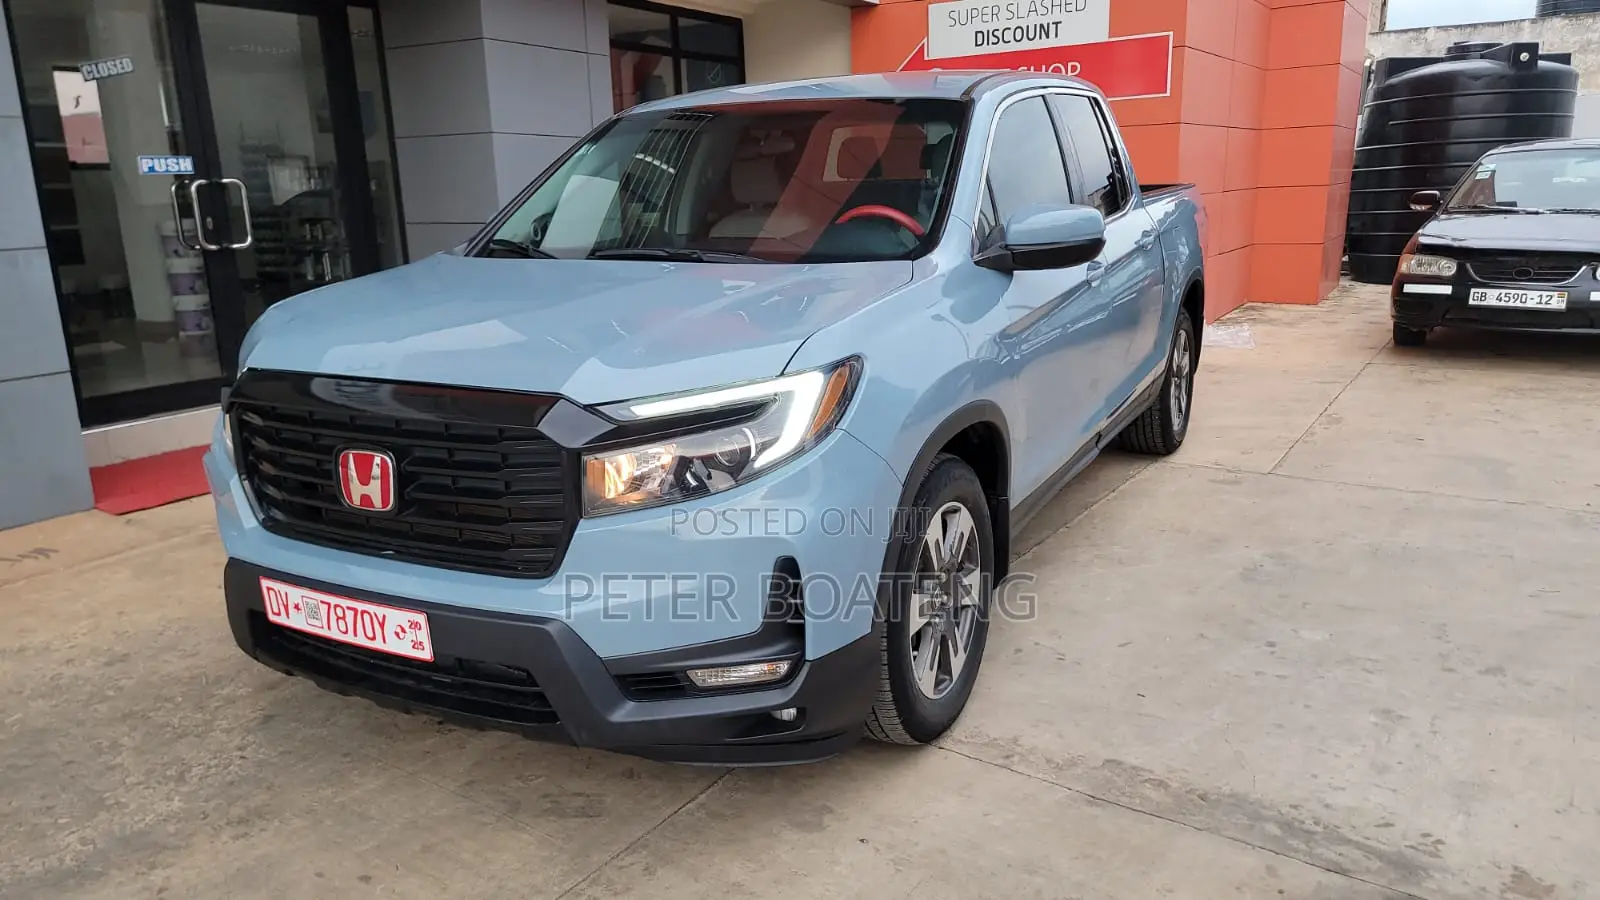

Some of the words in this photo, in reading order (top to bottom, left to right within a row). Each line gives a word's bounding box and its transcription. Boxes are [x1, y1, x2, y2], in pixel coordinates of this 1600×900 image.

[948, 4, 1001, 27] SUPER
[1005, 0, 1087, 20] SLASHED
[974, 21, 1062, 47] DISCOUNT
[82, 57, 134, 81] CLOSED
[140, 157, 193, 172] PUSH
[1472, 292, 1487, 302] GB
[265, 586, 290, 620] DV
